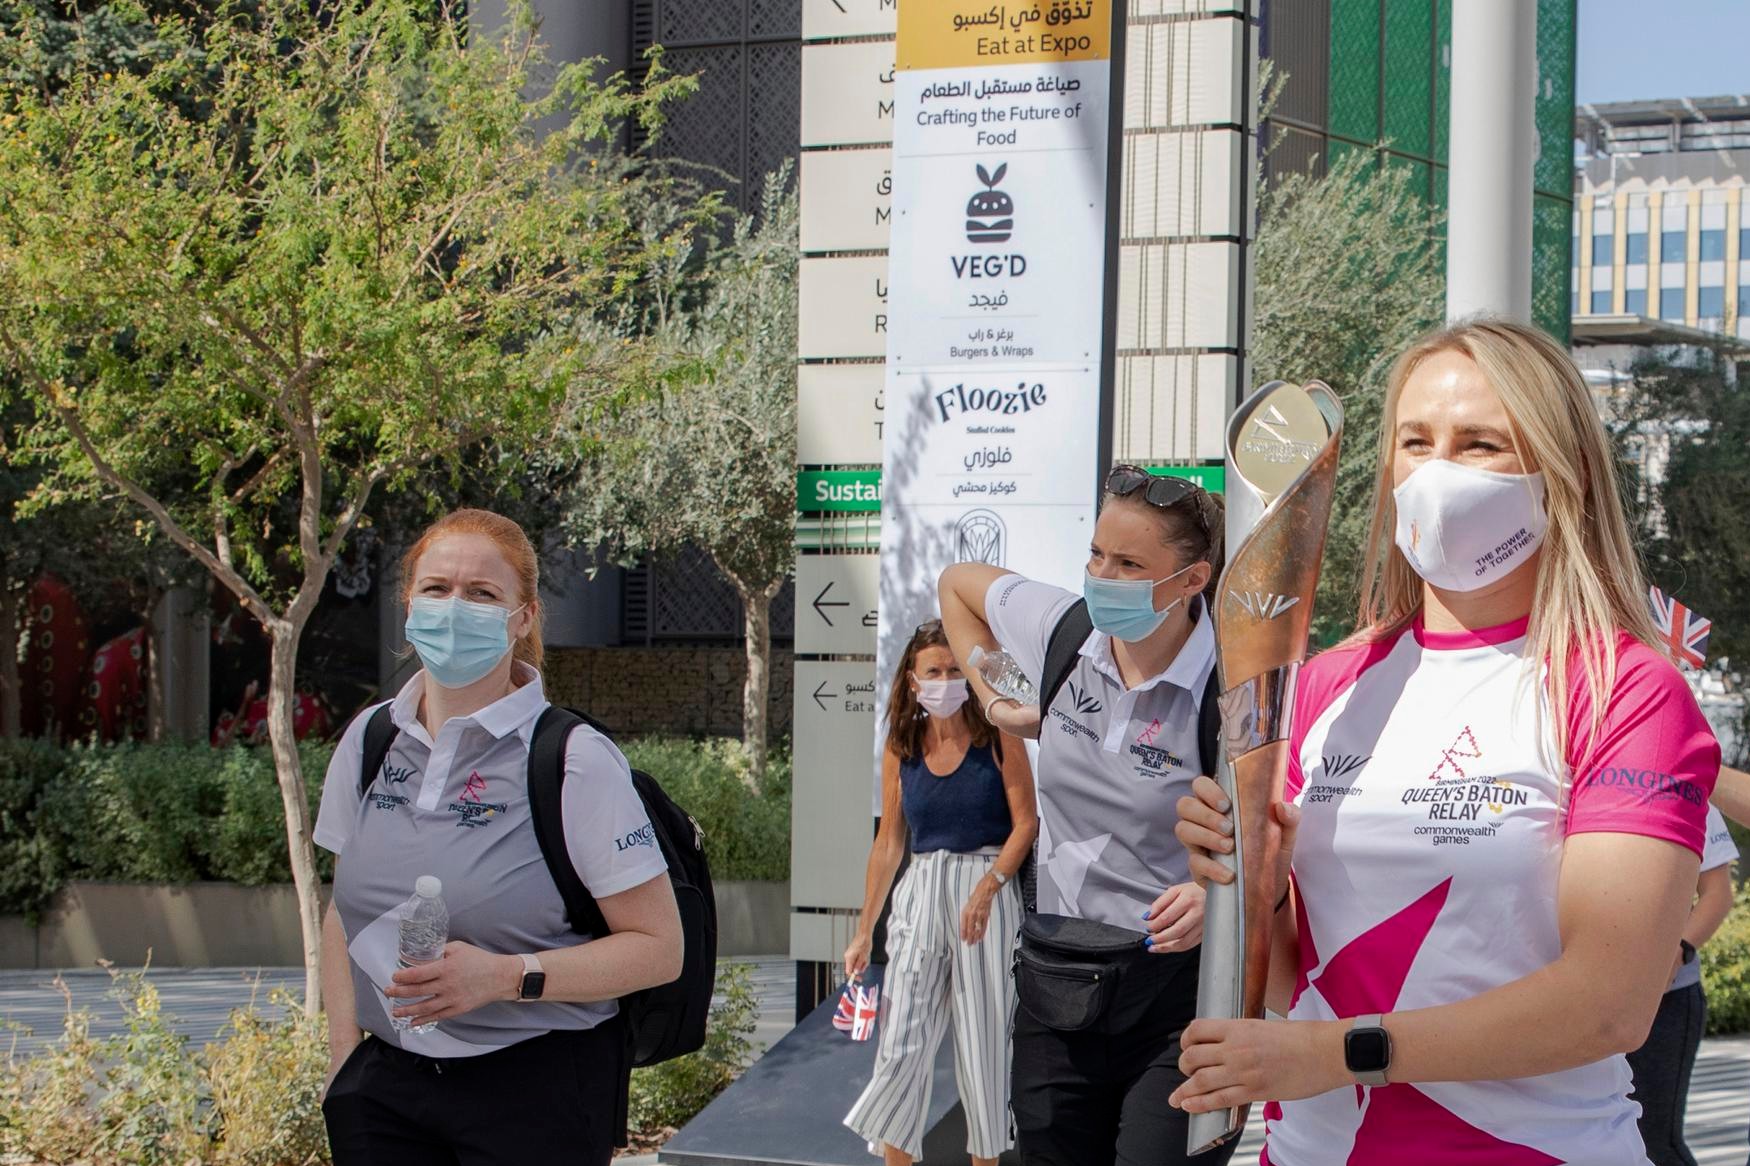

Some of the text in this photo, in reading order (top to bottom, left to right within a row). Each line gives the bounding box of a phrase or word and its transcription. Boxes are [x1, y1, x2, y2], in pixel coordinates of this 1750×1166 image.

[953, 6, 1005, 31] إكسبو
[1010, 4, 1041, 33] في
[977, 33, 1091, 56] Eat at Expo
[920, 76, 1081, 104] صياغة مستقبل الطعام
[917, 103, 1082, 127] Crafting the Future of
[977, 130, 1017, 146] Food
[951, 254, 1027, 279] VEG'D
[968, 290, 1008, 311] فيجد
[986, 329, 994, 340] &
[950, 345, 1034, 360] Burgers & Wraps
[935, 382, 1047, 423] Floozie
[964, 446, 1013, 472] فلوزي
[952, 481, 1017, 498] كوكيز محشي
[1475, 527, 1528, 568] THE POWER
[1475, 533, 1536, 577] OF TOGETHER
[845, 701, 865, 712] Eat
[1475, 776, 1497, 785] 2022
[1586, 767, 1704, 807] LONGINES
[1401, 784, 1528, 806] QUEEN'S BATON
[1428, 803, 1482, 821] RELAY
[1414, 823, 1496, 837] commonwealth
[1433, 836, 1470, 846] games
